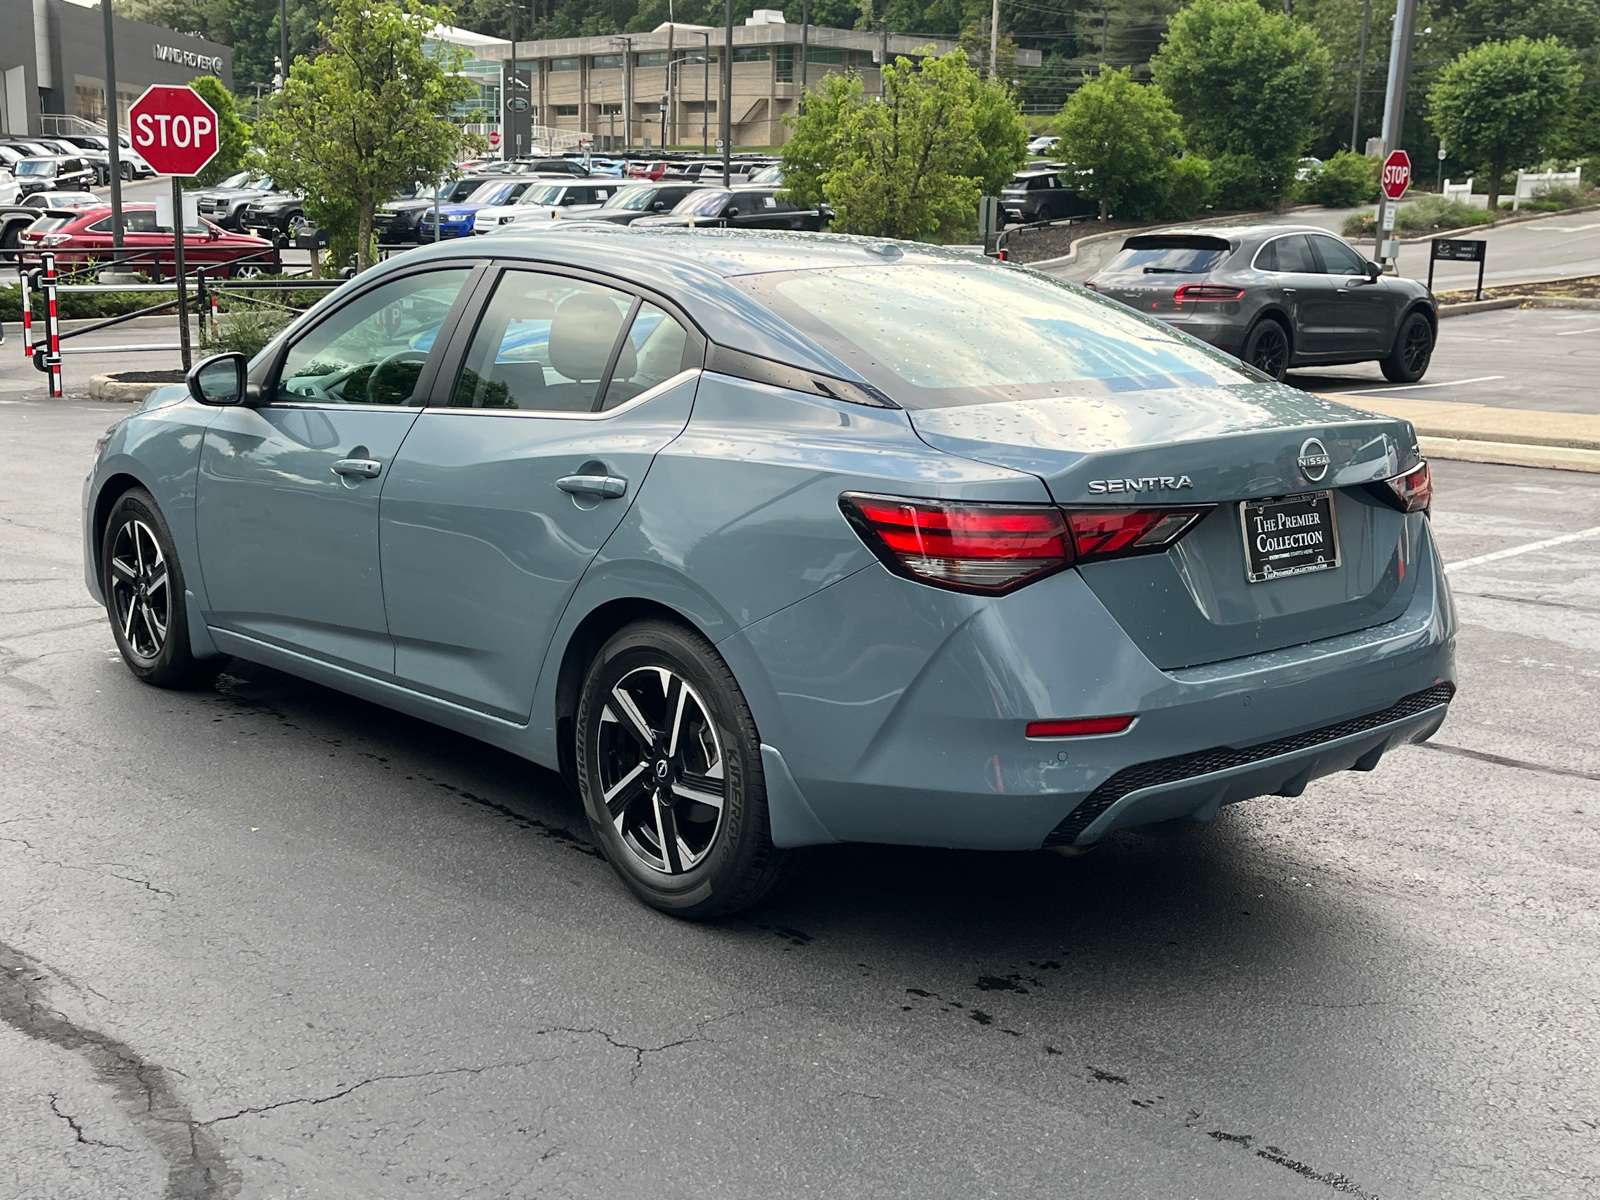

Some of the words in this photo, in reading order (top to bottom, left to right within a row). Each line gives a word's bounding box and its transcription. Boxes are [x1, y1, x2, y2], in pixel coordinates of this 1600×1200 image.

[136, 113, 212, 148] STOP
[1384, 165, 1409, 184] STOP
[1299, 456, 1331, 467] NISSAN
[1088, 475, 1194, 495] SENTRA
[1254, 516, 1277, 533] THE
[1277, 513, 1321, 530] PREMIER
[1256, 531, 1323, 553] COLLECTION
